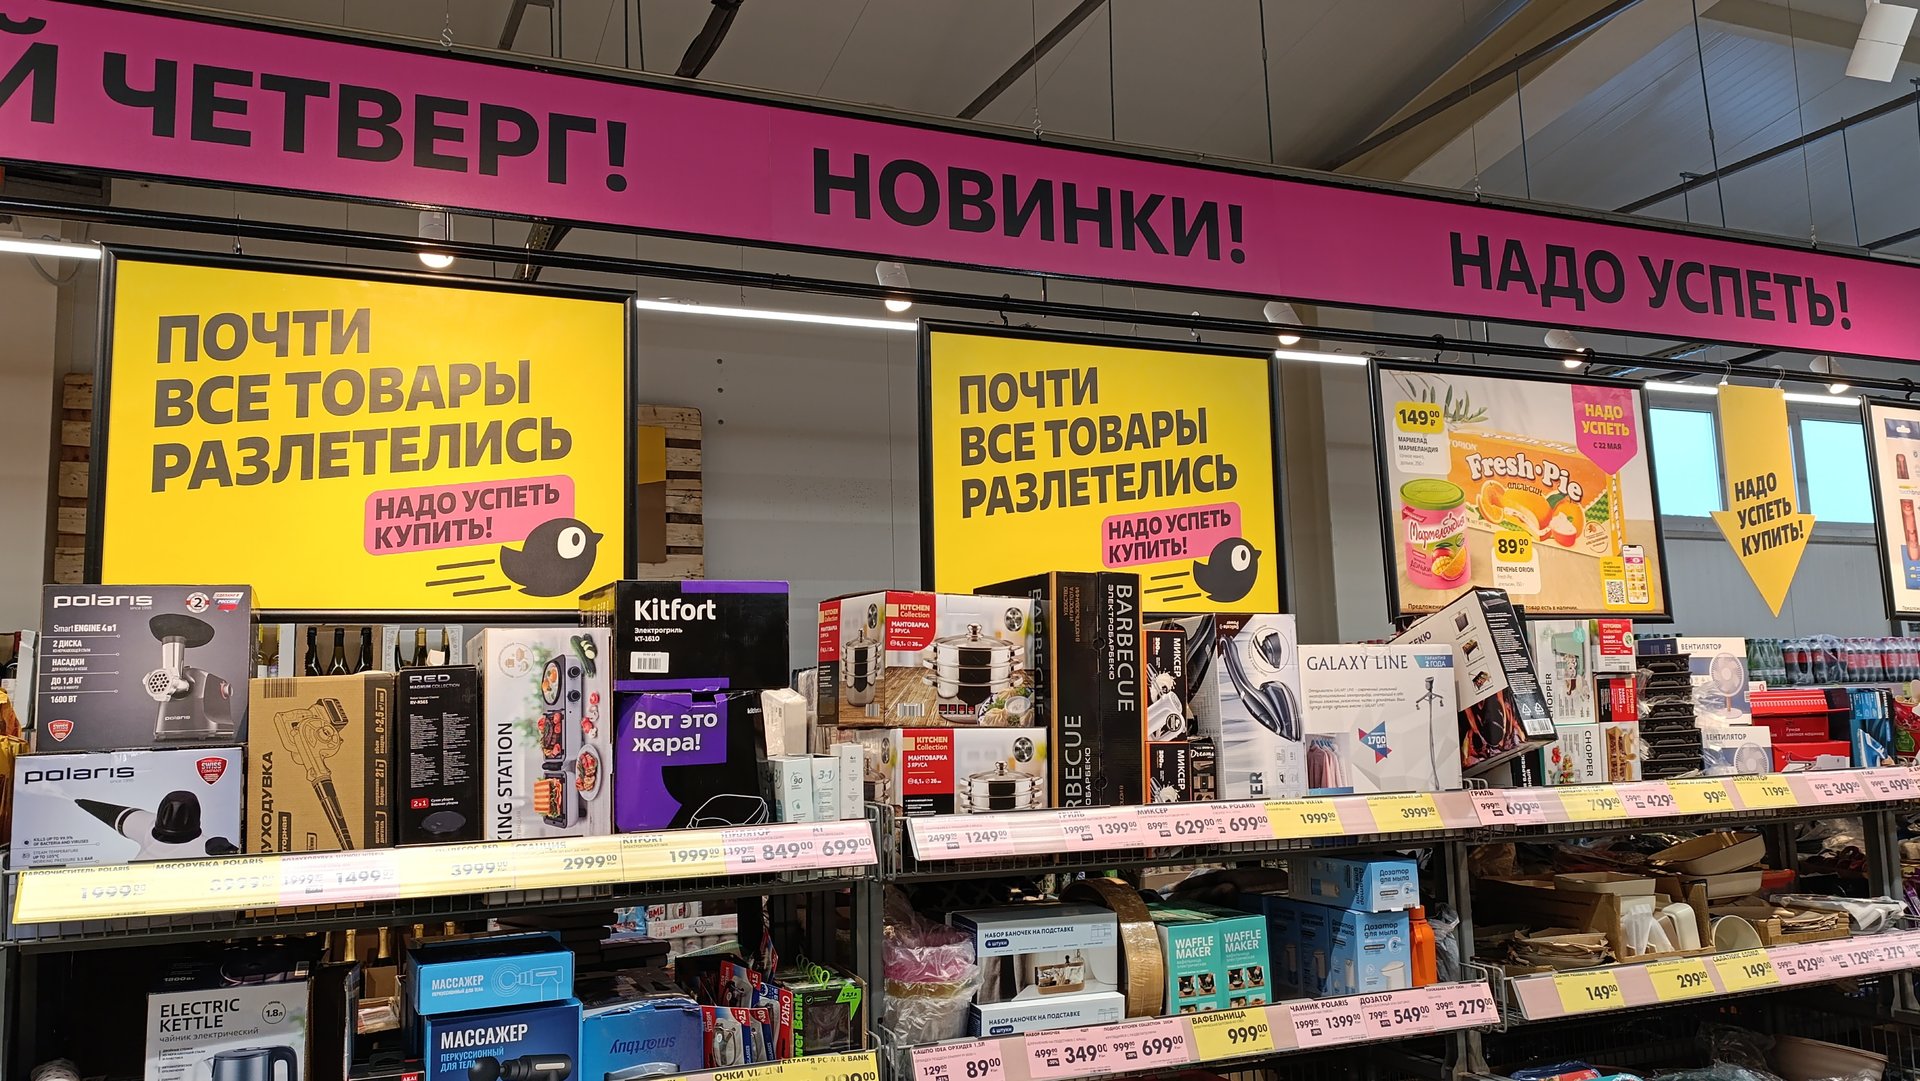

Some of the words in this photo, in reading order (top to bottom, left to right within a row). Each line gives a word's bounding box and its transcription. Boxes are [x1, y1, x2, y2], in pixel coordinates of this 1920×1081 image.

[103, 52, 628, 192] ЧЕТВЕРГ!
[813, 147, 1246, 264] НОВИНКИ!
[1449, 231, 1626, 312] НАДО
[1639, 256, 1852, 331] УСПЕТЬ!
[157, 308, 371, 364] ПОЧТИ
[154, 374, 270, 428] ВСЕ
[285, 360, 531, 417] ТОВАРЫ
[959, 367, 1099, 415] ПОЧТИ
[1584, 403, 1624, 420] НАДО
[1581, 420, 1630, 437] УСПЕТЬ
[960, 422, 1036, 467] ВСЕ
[1045, 407, 1207, 458] ТОВАРЫ
[1398, 437, 1427, 445] МАРМЕЛАД
[151, 416, 573, 492] РАЗЛЕТЕЛИСЬ
[1399, 445, 1439, 453] МАРМЕЛАНДИЯ
[1598, 442, 1608, 450] 22
[1608, 442, 1622, 451] МАЯ
[961, 454, 1238, 519] РАЗЛЕТЕЛИСЬ
[1735, 472, 1777, 502] НАДО
[375, 491, 456, 521] НАДО
[462, 482, 560, 514] УСПЕТЬ
[1737, 497, 1792, 530] УСПЕТЬ
[374, 516, 493, 550] КУПИТЬ!
[1108, 516, 1162, 541] НАДО
[1167, 509, 1232, 534] УСПЕТЬ
[1741, 520, 1804, 557] КУПИТЬ!
[1109, 537, 1188, 564] КУПИТЬ!
[53, 594, 152, 609] polaris
[194, 598, 202, 607] 2
[634, 598, 717, 621] Kitfort
[900, 603, 930, 612] KITCHEN
[1107, 584, 1115, 680] ЭЛЕКТРОБАРБЕКЮ
[53, 640, 57, 648] 2
[58, 640, 82, 648] ДИСКА
[1116, 584, 1134, 712] BARBECUE
[52, 658, 85, 666] НАСАДКИ
[1173, 637, 1181, 678] МИКСЕР
[1307, 656, 1368, 670] GALAXY
[1376, 655, 1408, 670] LINE
[51, 677, 61, 686] ДО
[409, 674, 451, 683] RED
[68, 695, 78, 703] ВТ
[634, 711, 674, 729] Вот
[680, 713, 718, 728] это
[633, 734, 701, 756] жара!
[1367, 736, 1386, 745] 1700
[498, 722, 512, 797] STATION
[1585, 730, 1594, 777] CHOPPER
[201, 761, 222, 770] SWISS
[1177, 750, 1185, 790] МИКСЕР
[24, 766, 135, 785] polaris
[1137, 807, 1168, 816] МИКСЕР
[222, 857, 264, 867] POLARIS
[1380, 869, 1409, 877] Дозатор
[1380, 876, 1391, 884] для
[1005, 929, 1032, 937] БАНОЧЕК
[1041, 926, 1074, 934] ПОДСТАВКЕ
[1364, 922, 1398, 931] Дозатор
[1364, 930, 1378, 938] для
[1175, 935, 1214, 949] WAFFLE
[1224, 929, 1262, 942] WAFFLE
[1176, 946, 1211, 960] MAKER
[1225, 940, 1259, 953] MAKER
[432, 975, 484, 991] МАССАЖЕР
[1321, 999, 1349, 1009] POLARIS
[1360, 995, 1393, 1005] ДОЗАТОР
[161, 999, 240, 1018] ELECTRIC
[780, 995, 791, 1027] ОЧКИ
[795, 993, 804, 1030] Bank
[160, 1015, 223, 1033] KETTLE
[989, 1018, 1009, 1026] НАБОР
[1010, 1016, 1037, 1024] БАНОЧЕК
[1047, 1011, 1080, 1019] ПОДСТАВКЕ
[1192, 1010, 1247, 1026] ВАФЕЛЬНИЦА
[160, 1033, 191, 1042] чайник
[194, 1027, 259, 1039] электрический
[441, 1023, 528, 1050] МАССАЖЕР
[610, 1036, 676, 1054] smartbuy
[948, 1043, 973, 1051] ОРХИДЕЯ
[440, 1046, 504, 1063] ПЕРКУССИОННЫЙ
[847, 1054, 869, 1062] BANK
[440, 1062, 457, 1073] ДЛЯ
[459, 1060, 476, 1071] ТЕЛА
[714, 1071, 744, 1081] ОЧКИ
